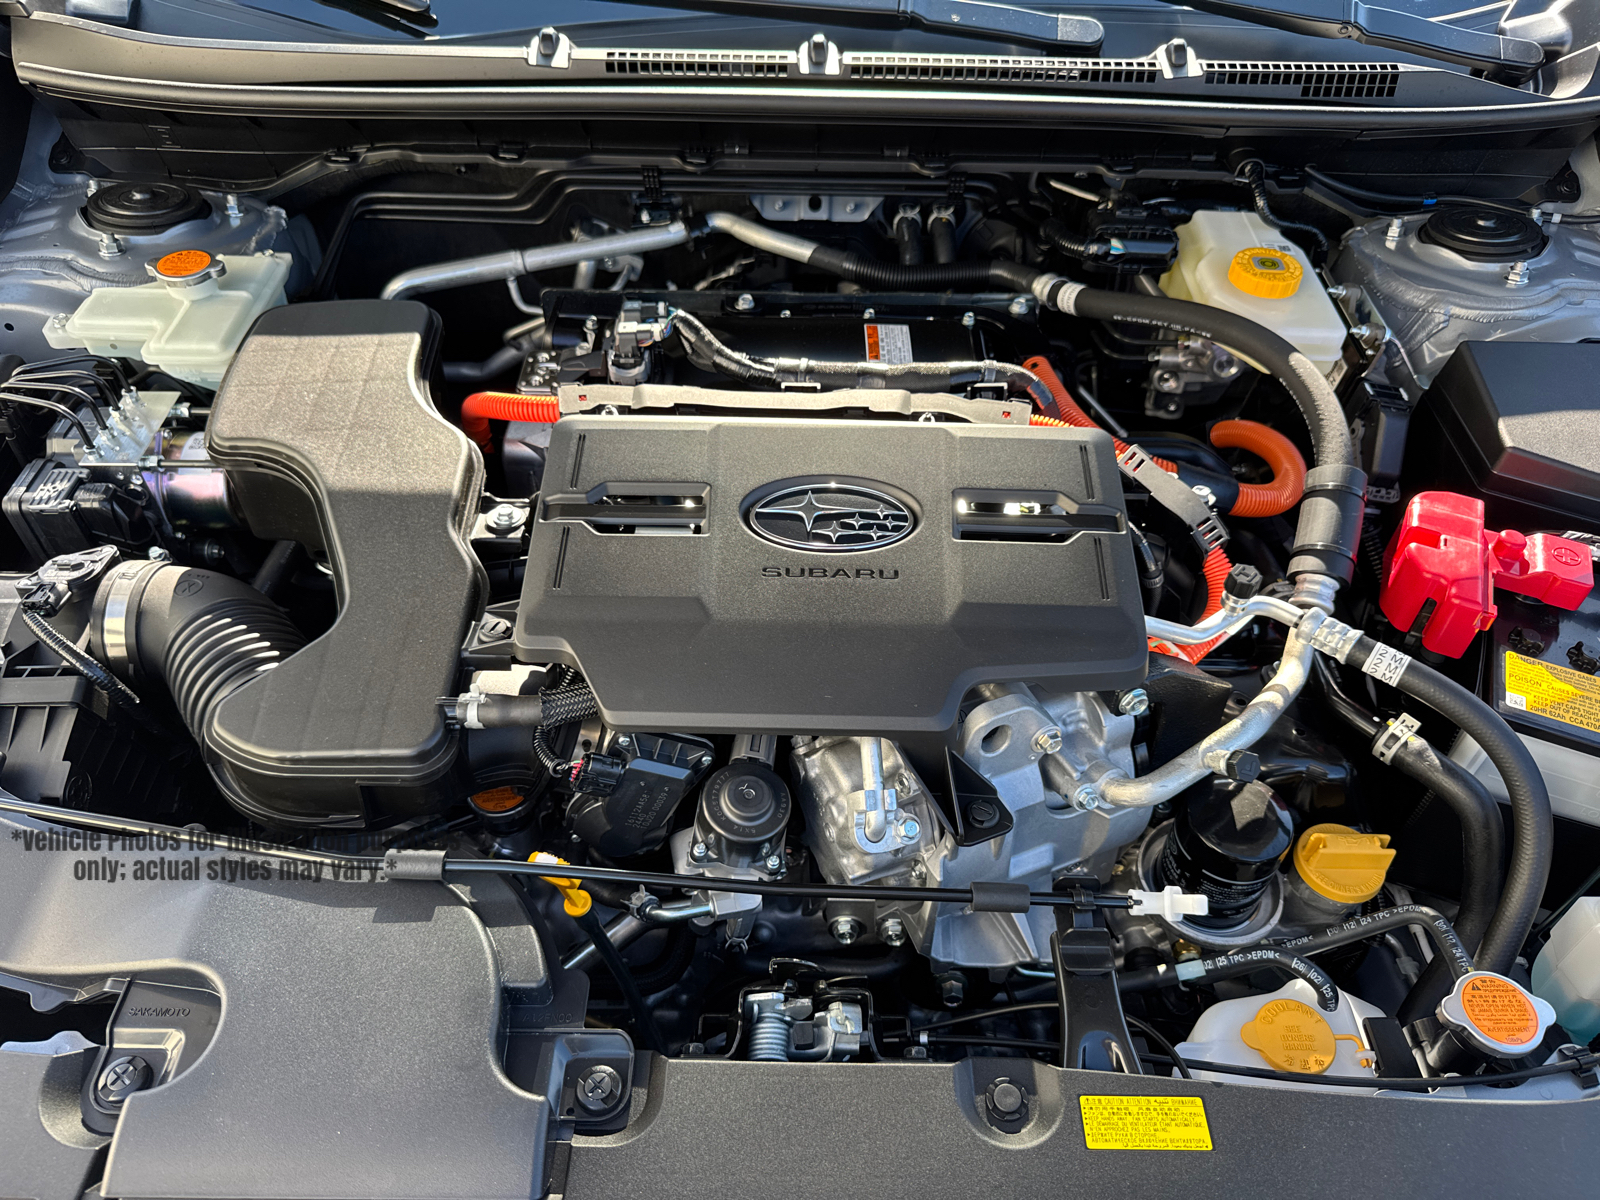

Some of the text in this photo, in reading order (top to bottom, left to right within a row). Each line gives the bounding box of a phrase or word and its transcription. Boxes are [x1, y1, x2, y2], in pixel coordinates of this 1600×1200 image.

[761, 567, 899, 580] SUBARU
[1391, 654, 1403, 665] M
[1385, 663, 1398, 675] M
[1508, 653, 1543, 667] DANGER
[1546, 664, 1576, 677] EXPLOSIVE
[1578, 674, 1597, 683] GASES
[1509, 672, 1542, 688] POISON
[1546, 684, 1570, 696] CAUSES
[1571, 691, 1593, 702] SEVERE
[1534, 700, 1548, 708] KEEP
[1550, 704, 1562, 712] OUT
[1572, 711, 1592, 720] REACH
[1550, 698, 1564, 708] VENT
[1566, 703, 1581, 712] CAPS
[1583, 708, 1599, 718] TIGHT
[1530, 704, 1548, 715] 20HR
[1548, 709, 1566, 720] 62Ah
[1569, 716, 1585, 726] CCA
[1312, 872, 1383, 894] SEE OWNER'S MANUAL
[1373, 910, 1390, 922] TPC
[1229, 954, 1244, 964] TPC
[1456, 956, 1469, 973] TPC
[128, 1006, 190, 1017] SAKAMOTO
[1261, 1001, 1324, 1024] COOLANT
[1326, 1000, 1336, 1013] TPC
[1284, 1025, 1302, 1033] SEE
[1280, 1034, 1316, 1042] OWNERS
[1282, 1042, 1318, 1052] MANUAL
